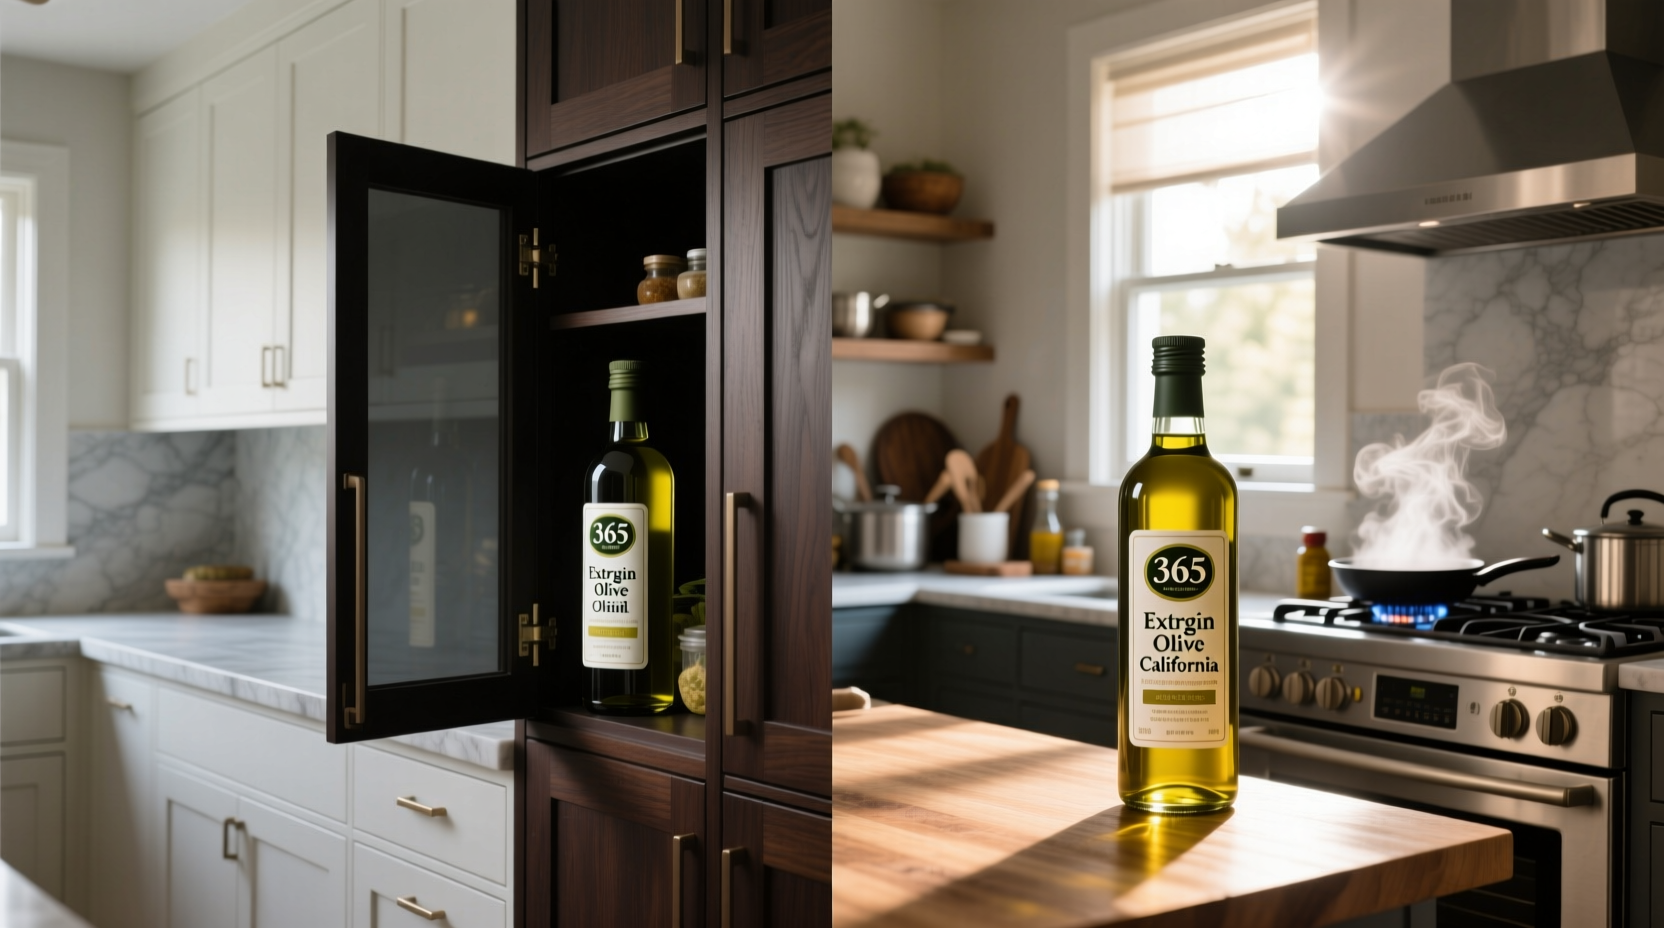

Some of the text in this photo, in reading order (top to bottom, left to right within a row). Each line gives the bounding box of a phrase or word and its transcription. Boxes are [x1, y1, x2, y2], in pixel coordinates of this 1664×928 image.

[593, 522, 629, 544] 365
[589, 566, 636, 583] Extrgin
[1153, 555, 1207, 584] 365
[594, 582, 629, 596] Olive
[1143, 612, 1215, 636] Extrgin
[1153, 634, 1205, 652] Olive
[1139, 655, 1219, 673] California
